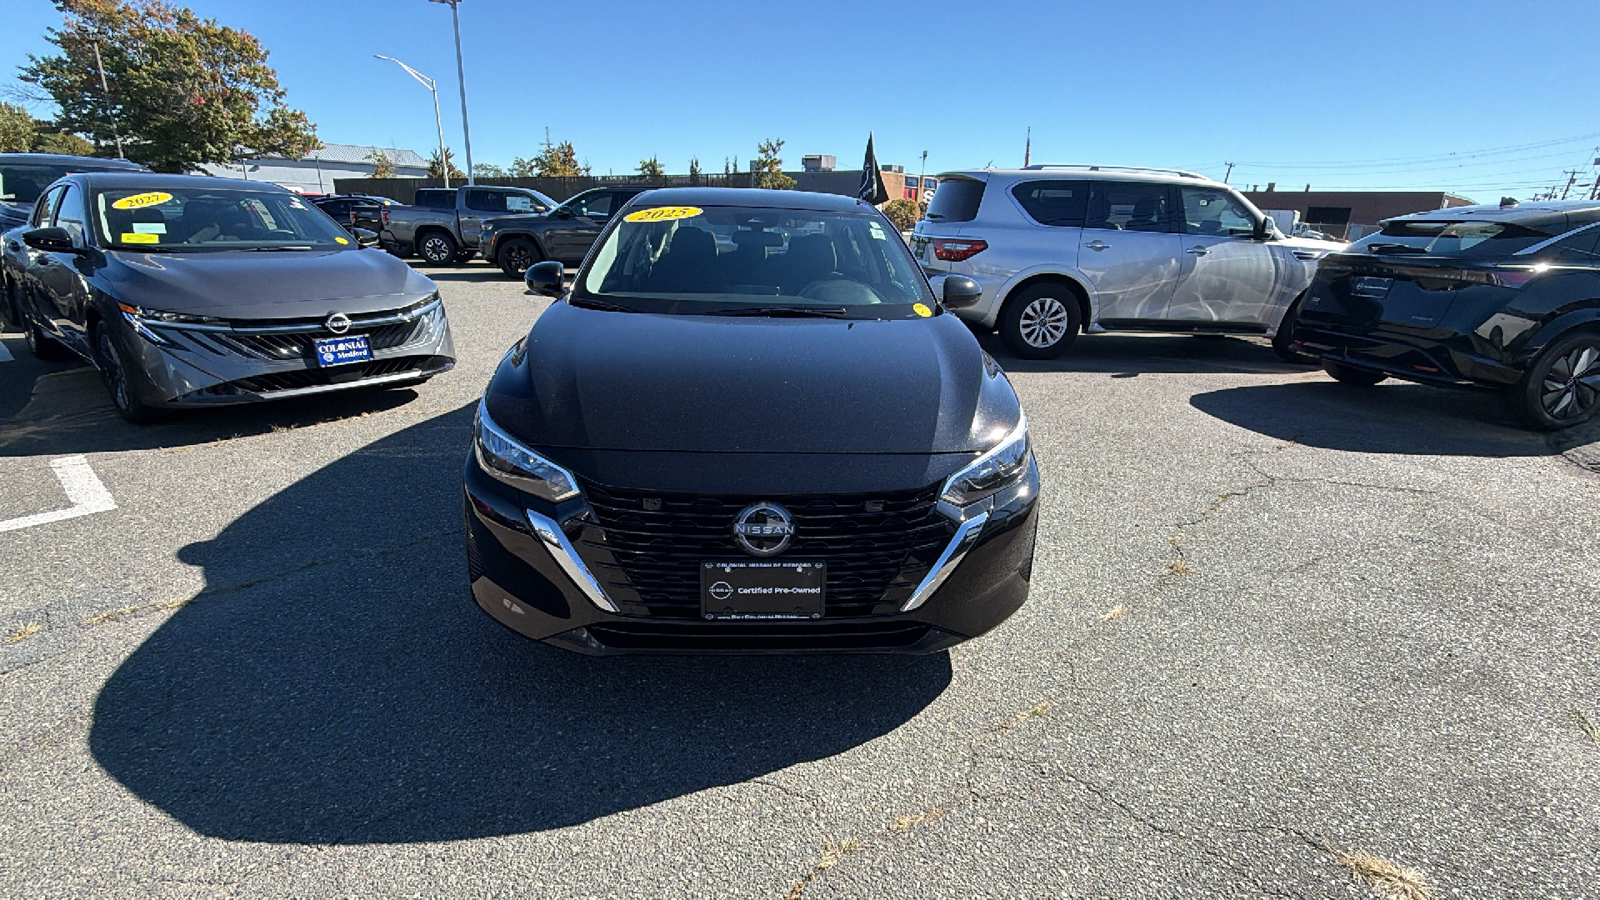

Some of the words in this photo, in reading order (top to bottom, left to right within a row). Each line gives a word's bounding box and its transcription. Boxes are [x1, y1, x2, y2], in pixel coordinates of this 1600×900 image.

[126, 195, 159, 207] 2027
[638, 208, 691, 220] 2025
[318, 341, 367, 353] COLONIAL
[337, 349, 367, 358] Medford
[735, 525, 794, 534] NISSAN
